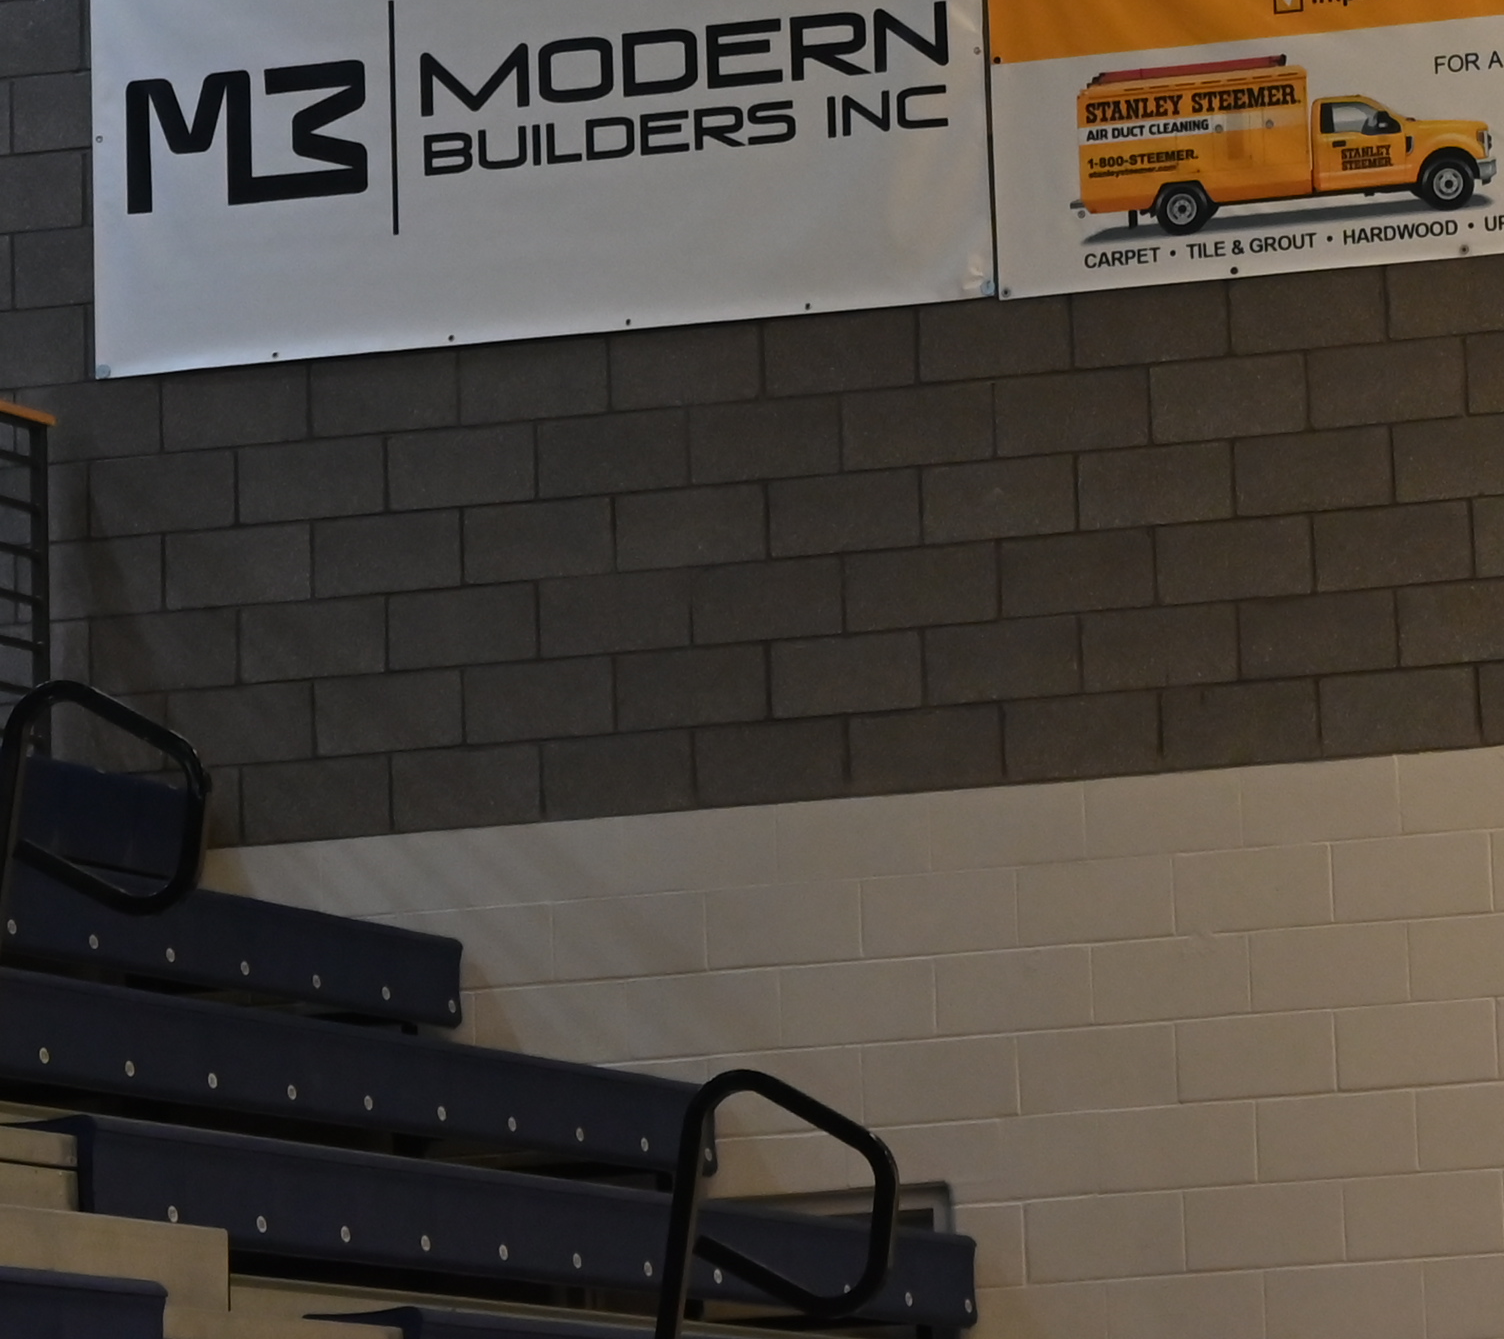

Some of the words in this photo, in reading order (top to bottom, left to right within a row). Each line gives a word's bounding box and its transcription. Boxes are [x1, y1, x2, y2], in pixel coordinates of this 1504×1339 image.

[419, 0, 950, 118] MODERN
[1434, 52, 1481, 75] FOR
[1487, 51, 1504, 69] A
[1085, 90, 1183, 124] STANLEY
[423, 99, 798, 177] BUILDERS
[827, 83, 950, 141] INC
[1086, 129, 1109, 143] AIR
[1111, 125, 1146, 139] DUCT
[1148, 118, 1210, 136] CLEANING
[1340, 144, 1392, 160] STANLEY
[1084, 245, 1161, 269] CARPET
[1186, 240, 1227, 262] TILE
[1232, 238, 1246, 257] &
[1249, 231, 1317, 254] GROUT
[1342, 219, 1459, 245] HARDWOOD
